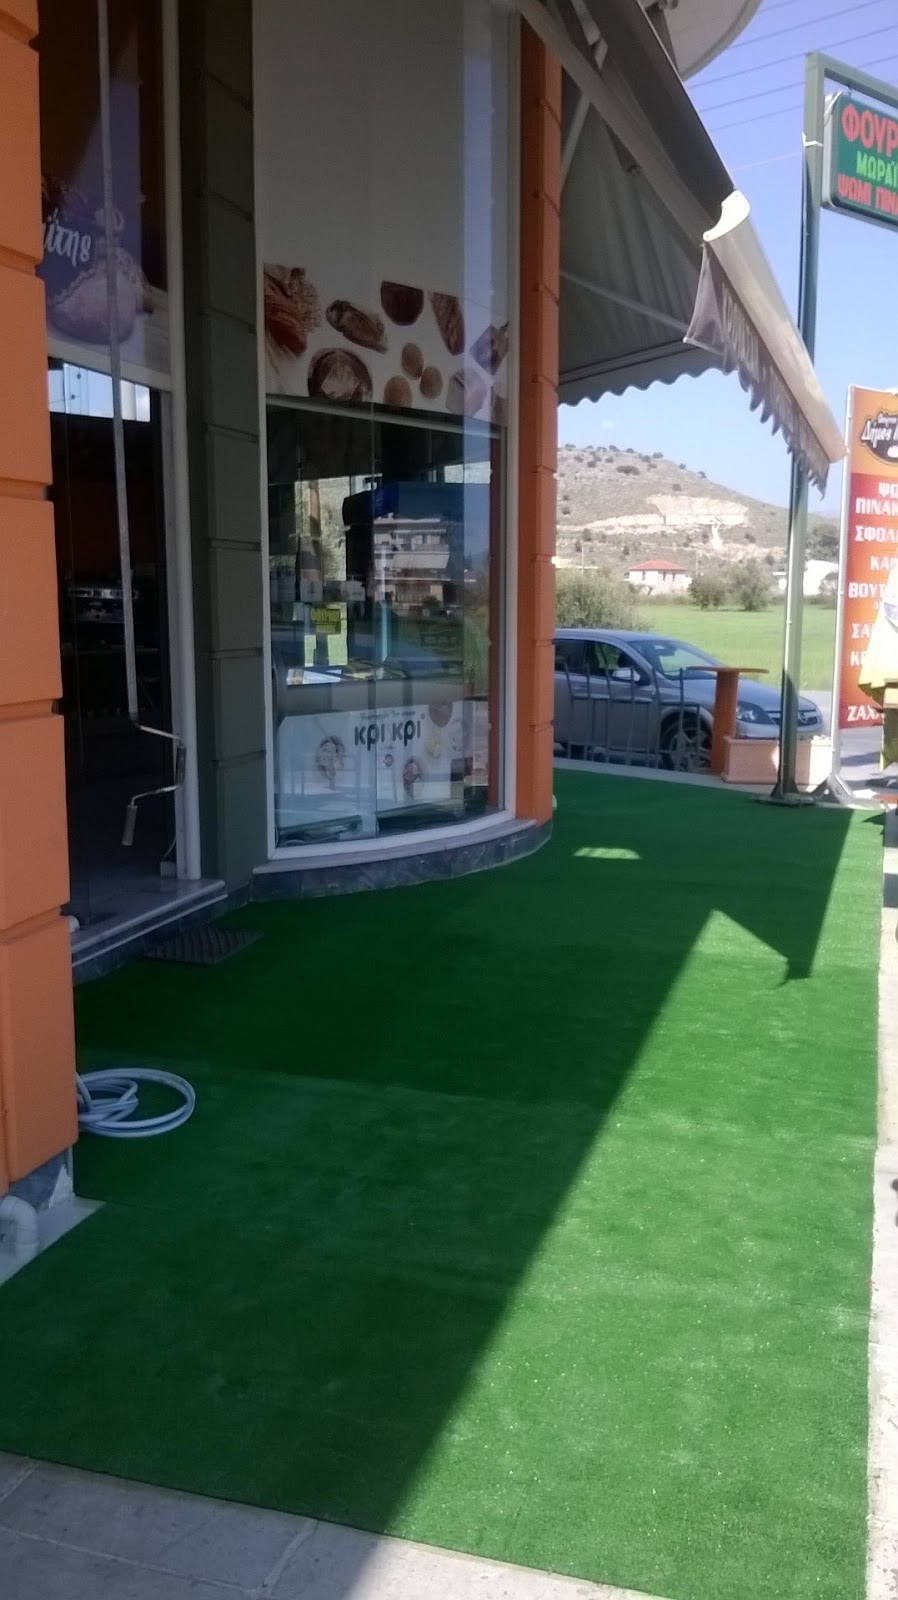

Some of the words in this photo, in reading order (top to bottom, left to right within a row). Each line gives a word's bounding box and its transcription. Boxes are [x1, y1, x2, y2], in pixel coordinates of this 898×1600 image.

[841, 104, 898, 157] ΦΟΥΡ
[837, 173, 872, 206] ΨΩΜΙ
[852, 623, 875, 639] ΣΑ
